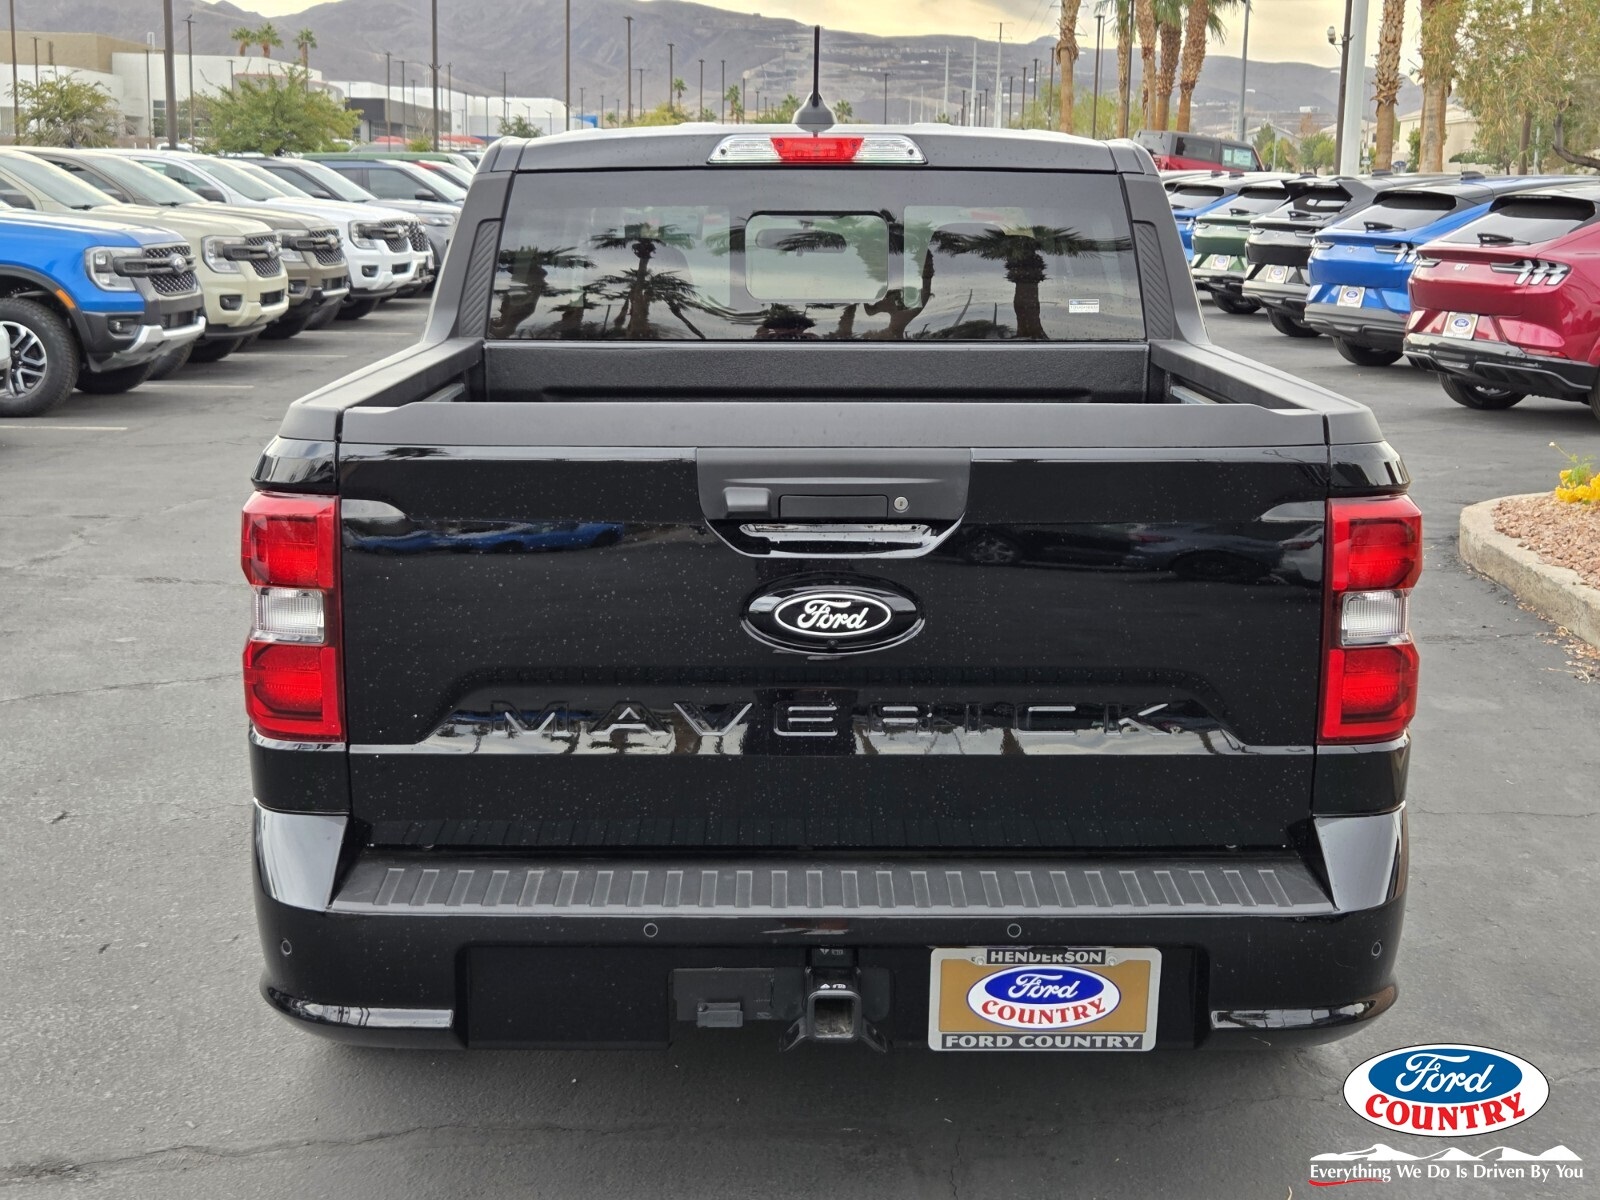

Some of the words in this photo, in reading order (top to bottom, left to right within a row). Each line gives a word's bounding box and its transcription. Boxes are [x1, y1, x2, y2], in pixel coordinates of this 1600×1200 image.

[797, 599, 870, 629] Ford
[491, 701, 1171, 737] MAVERICK
[990, 951, 1102, 963] HENDERSON
[1007, 973, 1081, 999] Ford
[981, 998, 1106, 1025] COUNTRY
[945, 1035, 1013, 1048] FORD
[1018, 1035, 1140, 1048] COUNTRY
